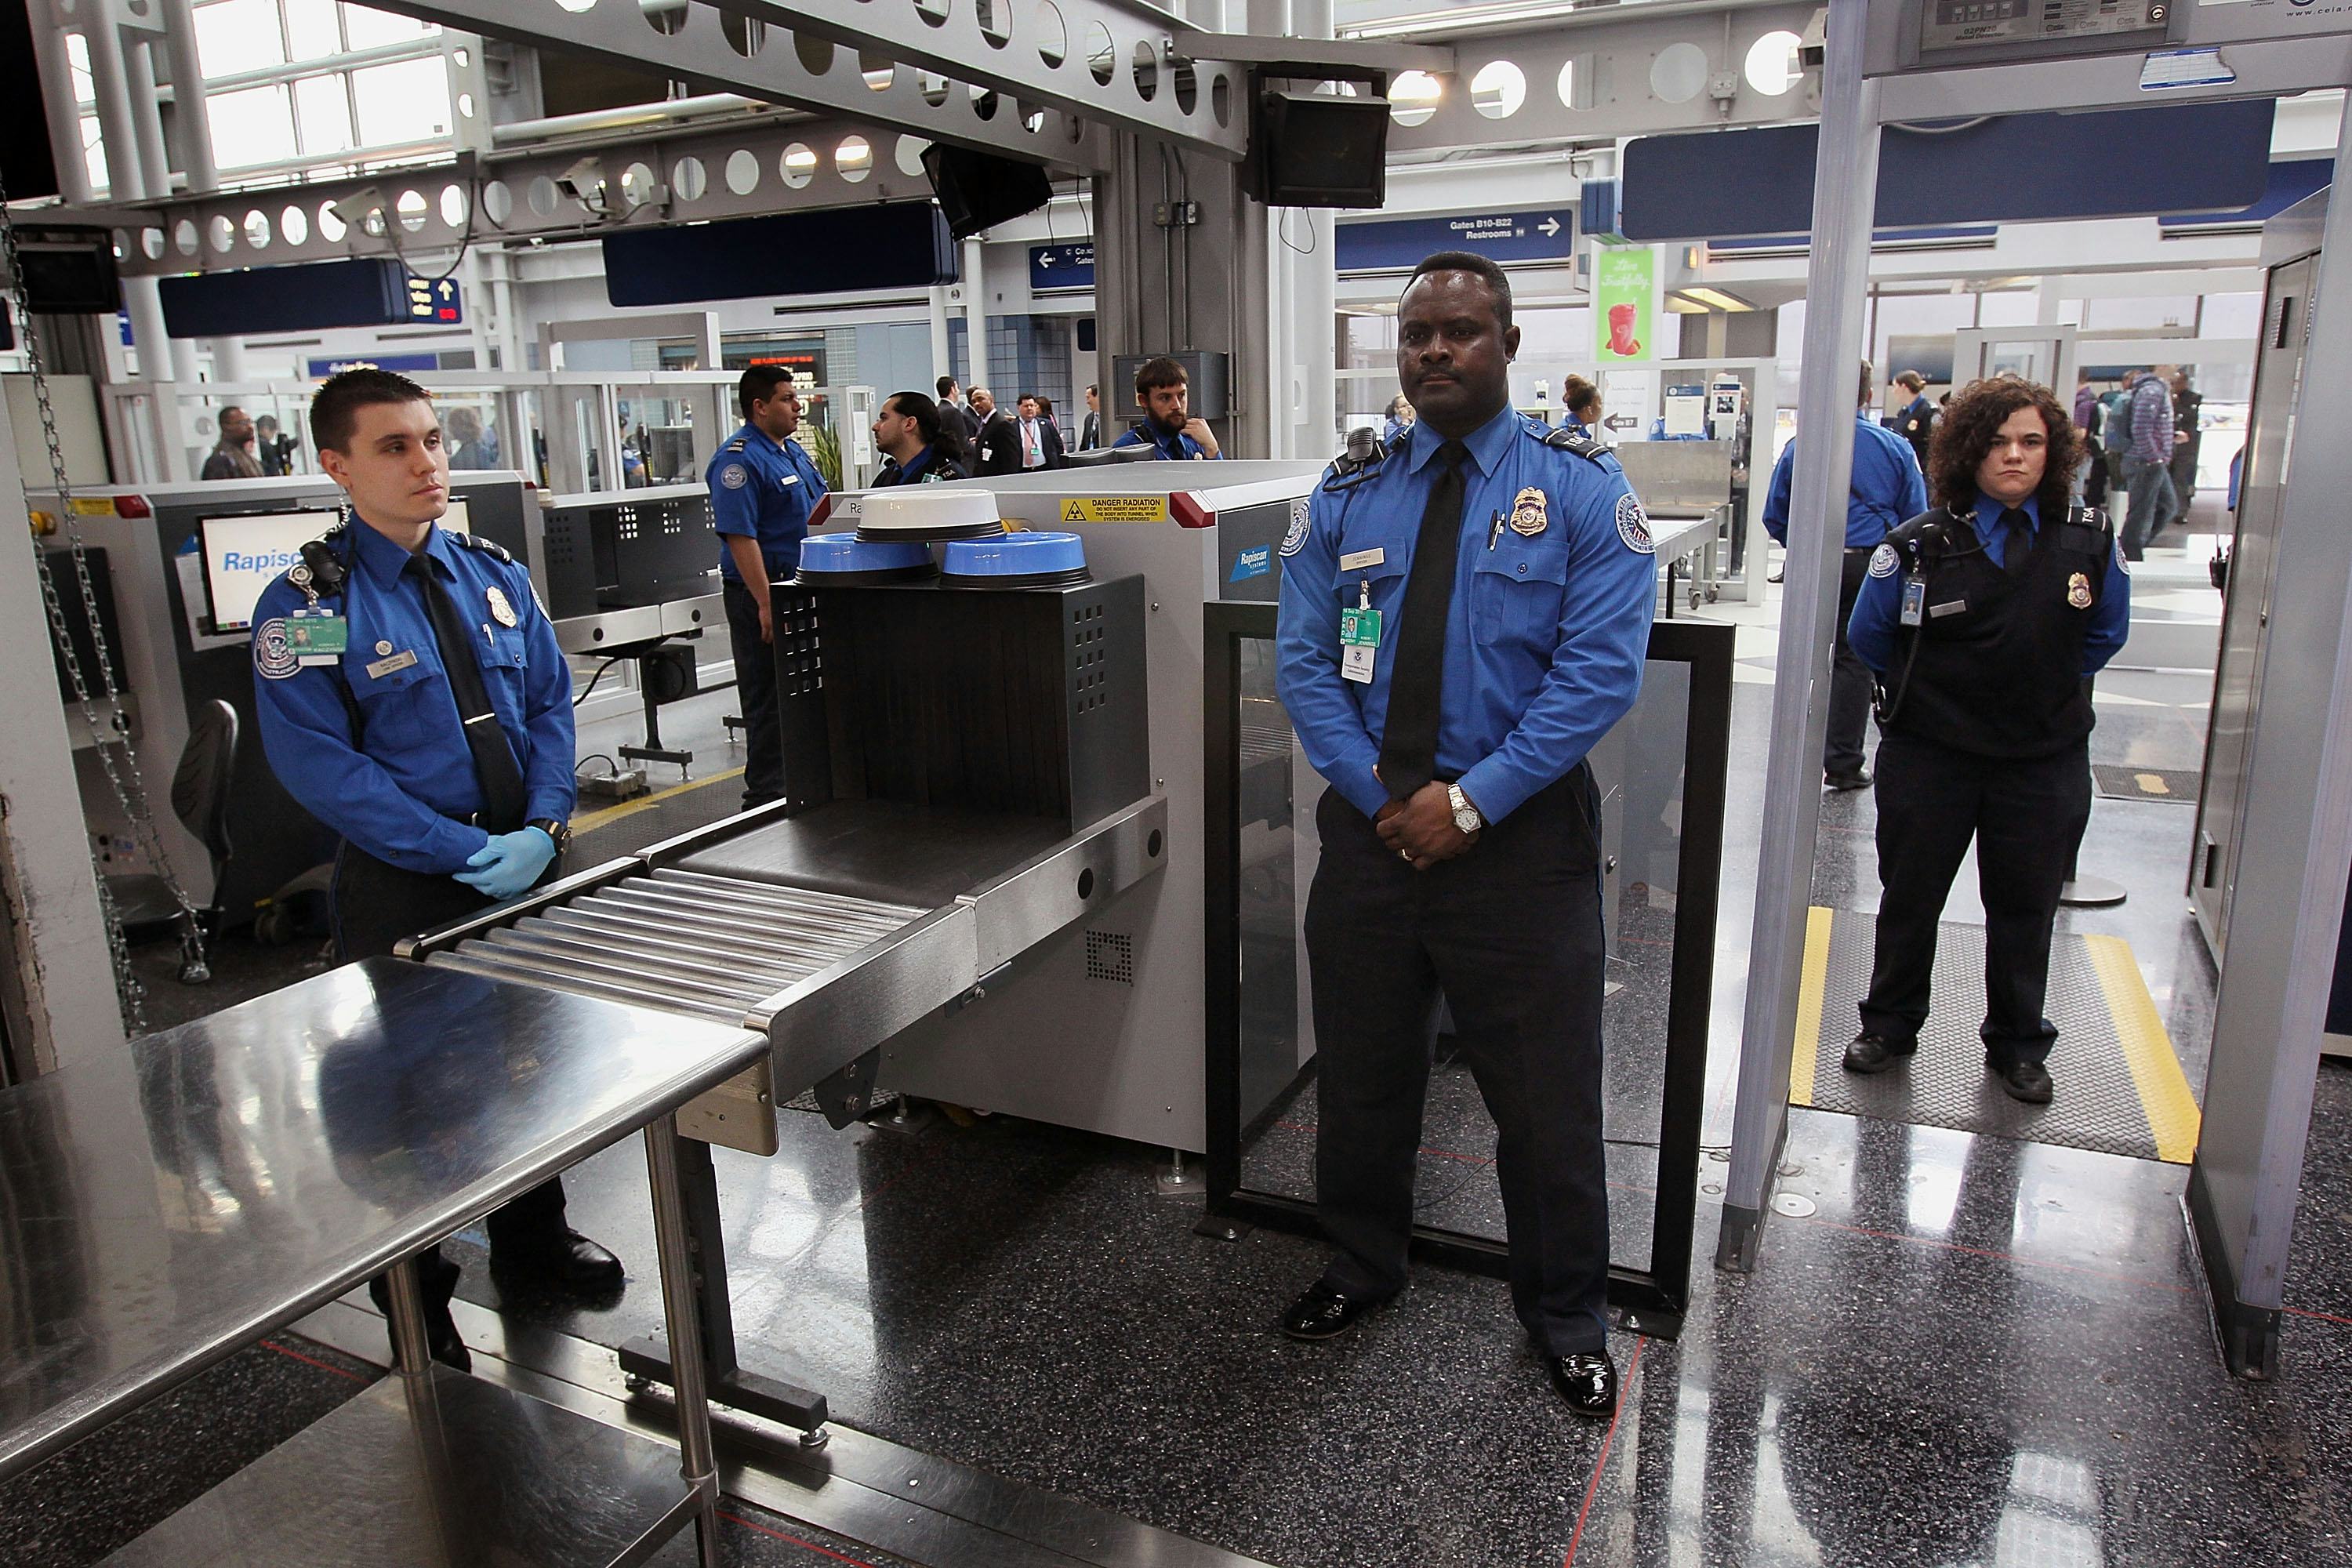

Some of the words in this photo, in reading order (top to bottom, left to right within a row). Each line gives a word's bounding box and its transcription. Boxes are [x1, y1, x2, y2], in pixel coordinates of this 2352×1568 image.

[1476, 219, 1512, 228] B10-B22
[1466, 230, 1512, 239] Restrooms
[1563, 435, 1588, 446] TSA
[2082, 507, 2094, 522] TSA
[1241, 550, 1267, 565] Rapiscan
[1250, 561, 1266, 569] systems
